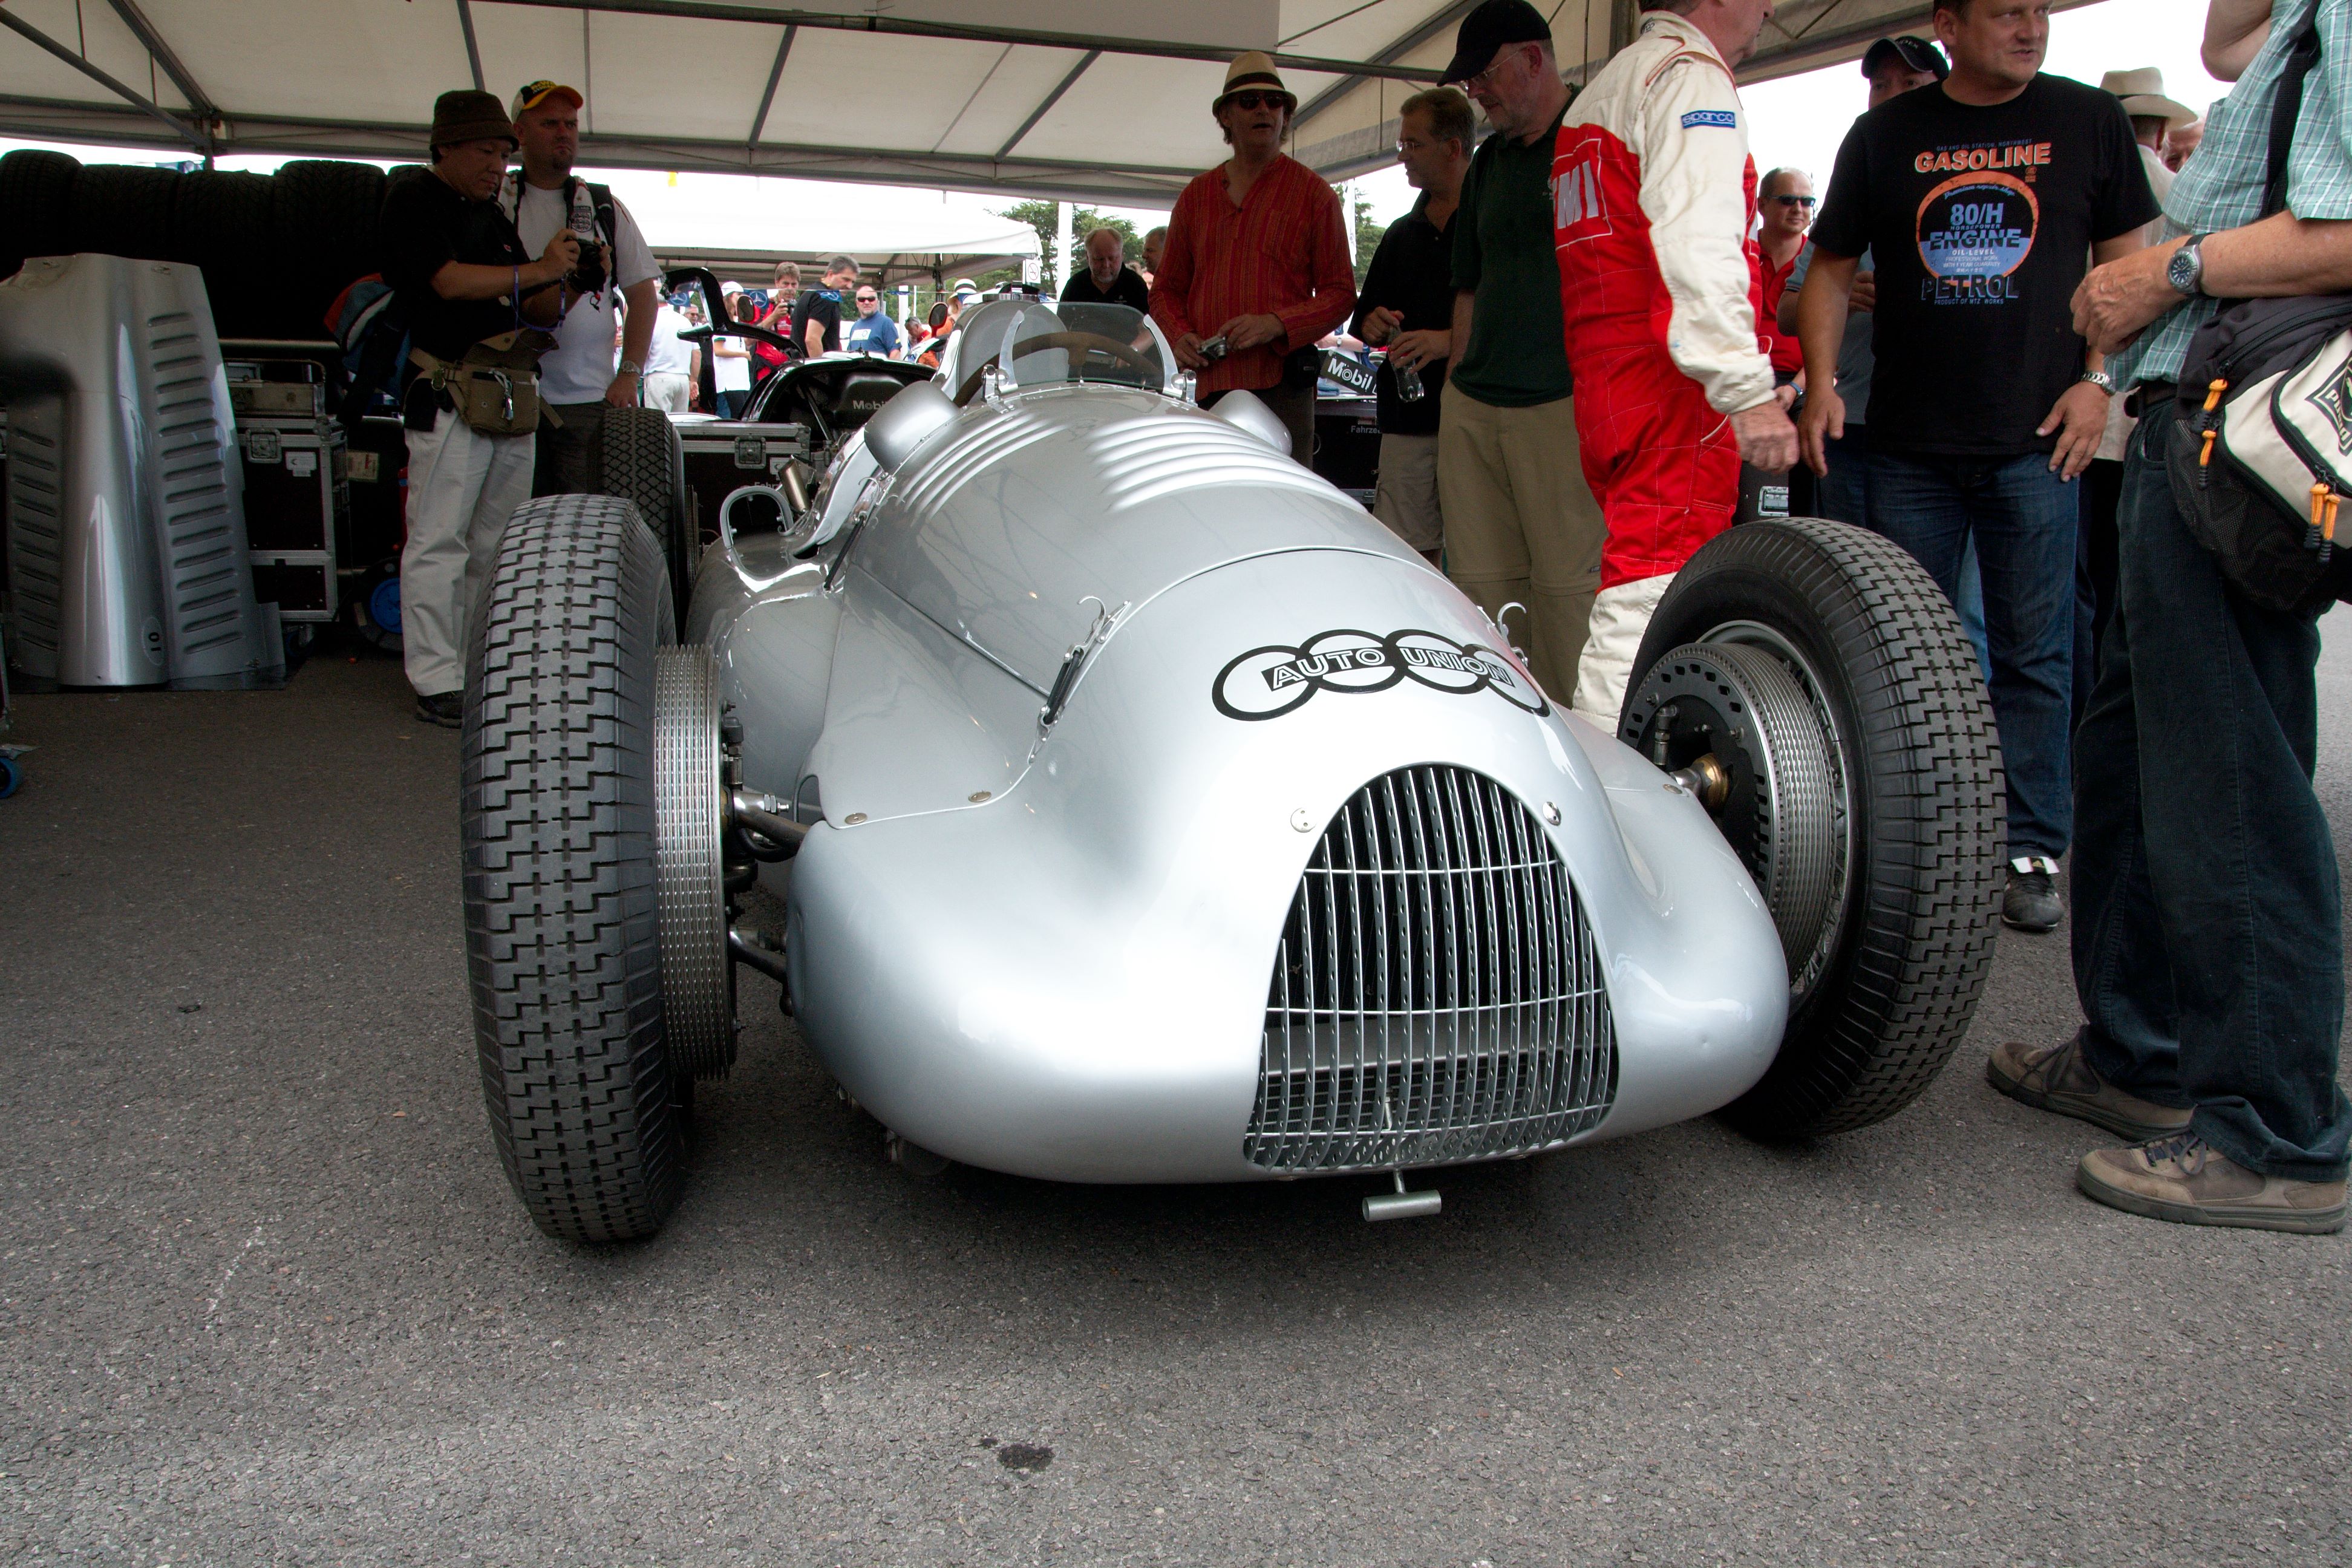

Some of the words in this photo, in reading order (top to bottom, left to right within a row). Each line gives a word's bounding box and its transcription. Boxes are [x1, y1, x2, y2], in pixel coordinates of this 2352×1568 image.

[1682, 113, 1734, 125] sparco
[1915, 142, 2051, 173] GASOLINE
[1552, 160, 1599, 229] MI
[1950, 203, 2004, 226] 80/H
[1930, 229, 2022, 251] ENGINE
[1921, 274, 2019, 301] PETROL
[1328, 358, 1373, 390] Mobil
[1272, 647, 1385, 689] AUTO
[1399, 647, 1513, 685] UNION
